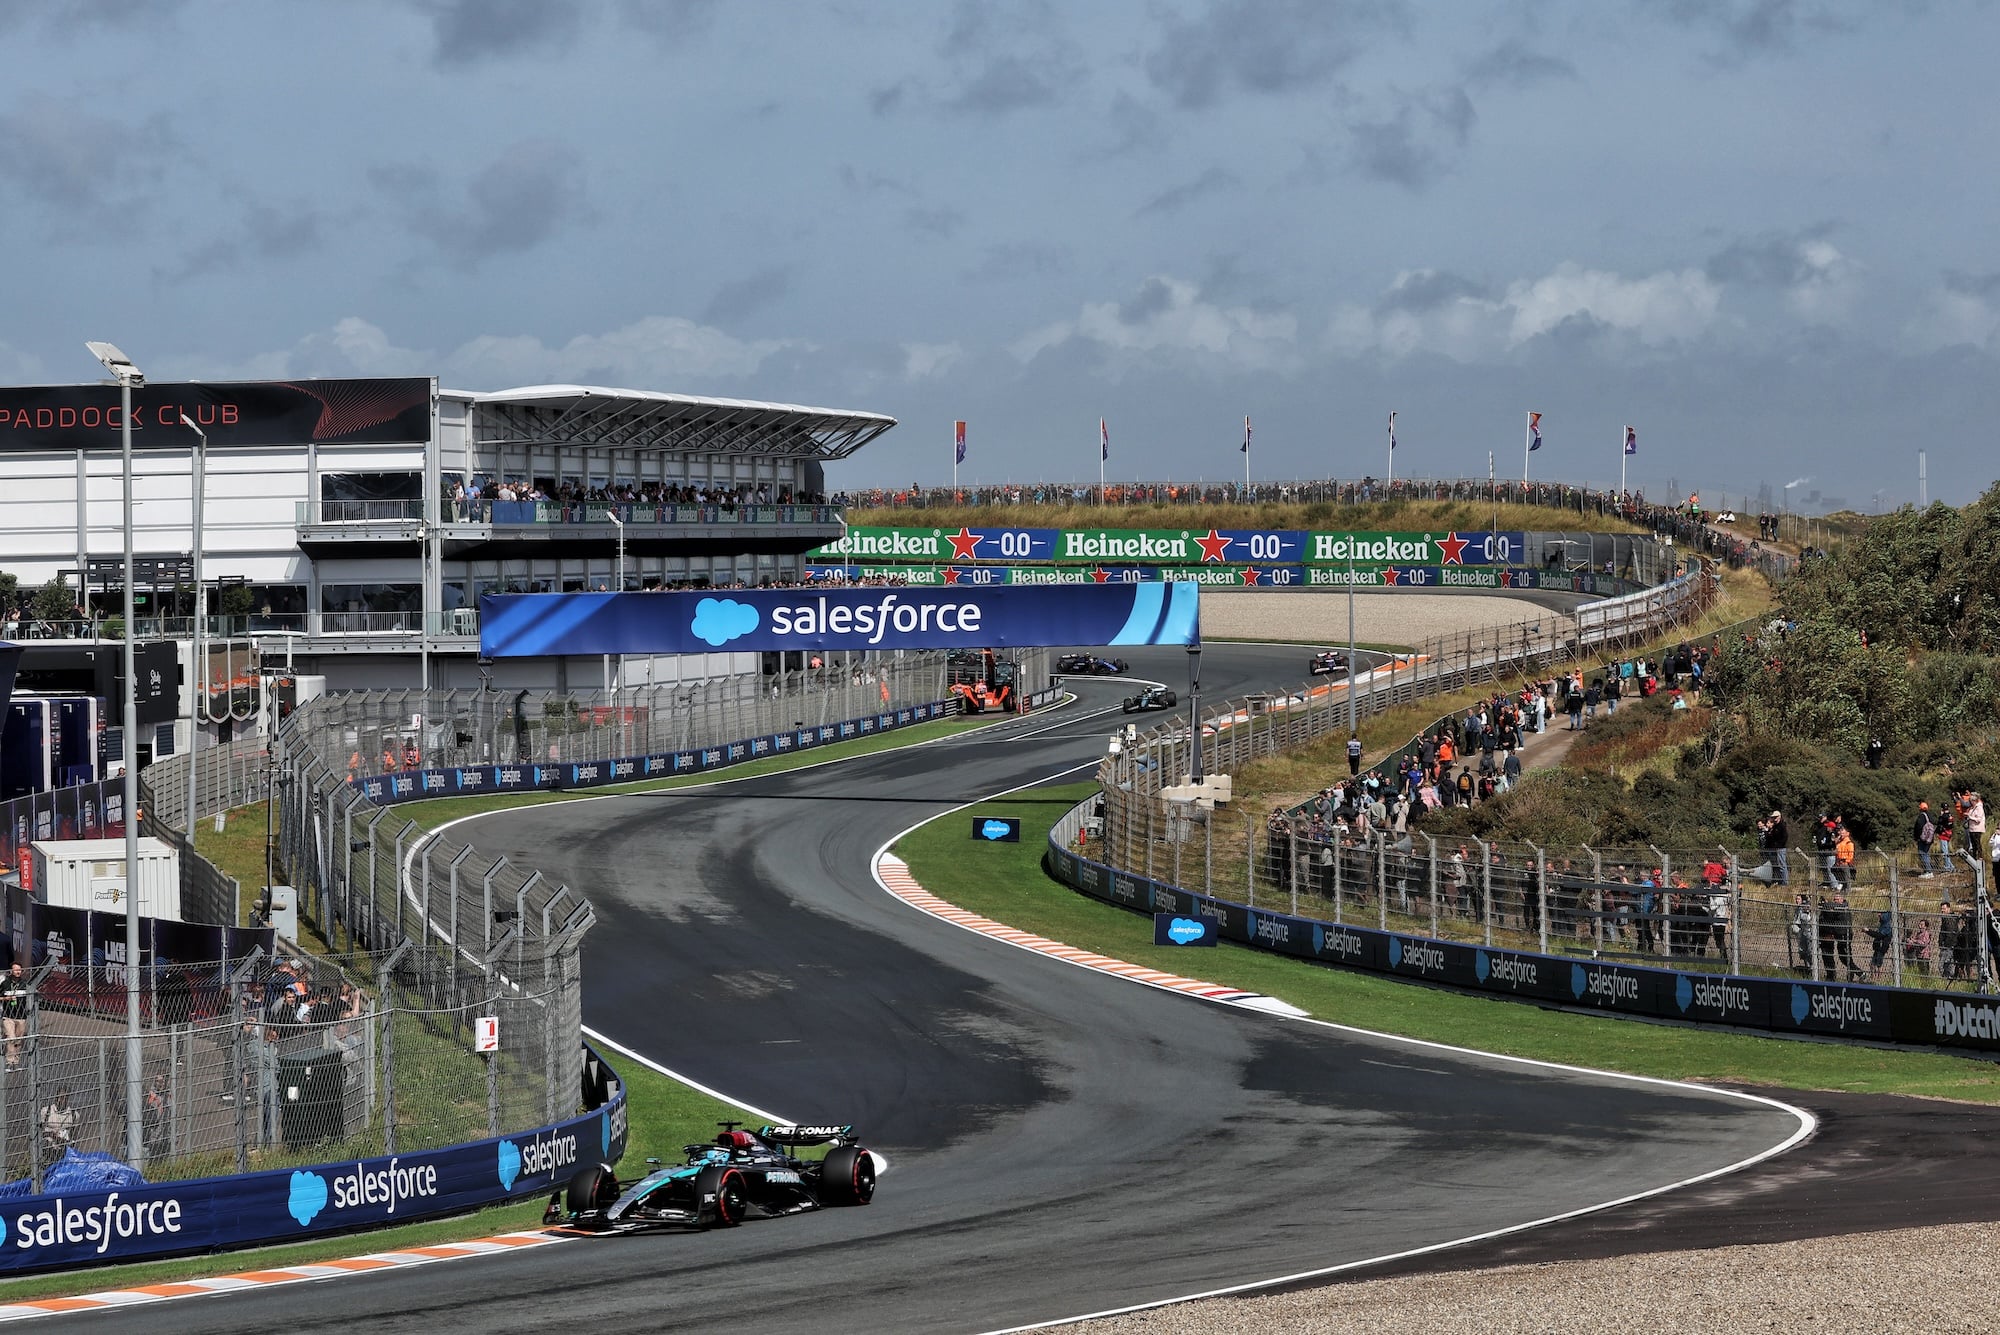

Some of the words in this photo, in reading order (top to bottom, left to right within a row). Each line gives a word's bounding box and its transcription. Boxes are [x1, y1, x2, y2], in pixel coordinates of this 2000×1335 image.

[158, 404, 239, 425] CLUB
[1001, 532, 1031, 556] 0.0
[1250, 534, 1281, 559] 0.0
[1122, 569, 1141, 583] 00
[771, 594, 981, 644] salesforce
[1173, 926, 1201, 935] salesforce
[1257, 916, 1289, 946] salesforce
[1324, 926, 1361, 959] salesforce
[105, 961, 128, 986] OTH
[1403, 939, 1444, 974] salesforce
[1491, 952, 1537, 989] salesforce
[1588, 964, 1638, 1005] salesforce
[1694, 973, 1749, 1016] salesforce
[1811, 985, 1872, 1029] salesforce
[1934, 999, 2000, 1040] #Dutch
[773, 1126, 841, 1136] PETRONAS
[523, 1128, 577, 1180] salesforce
[333, 1157, 437, 1214] salesforce
[16, 1192, 182, 1253] salesforce
